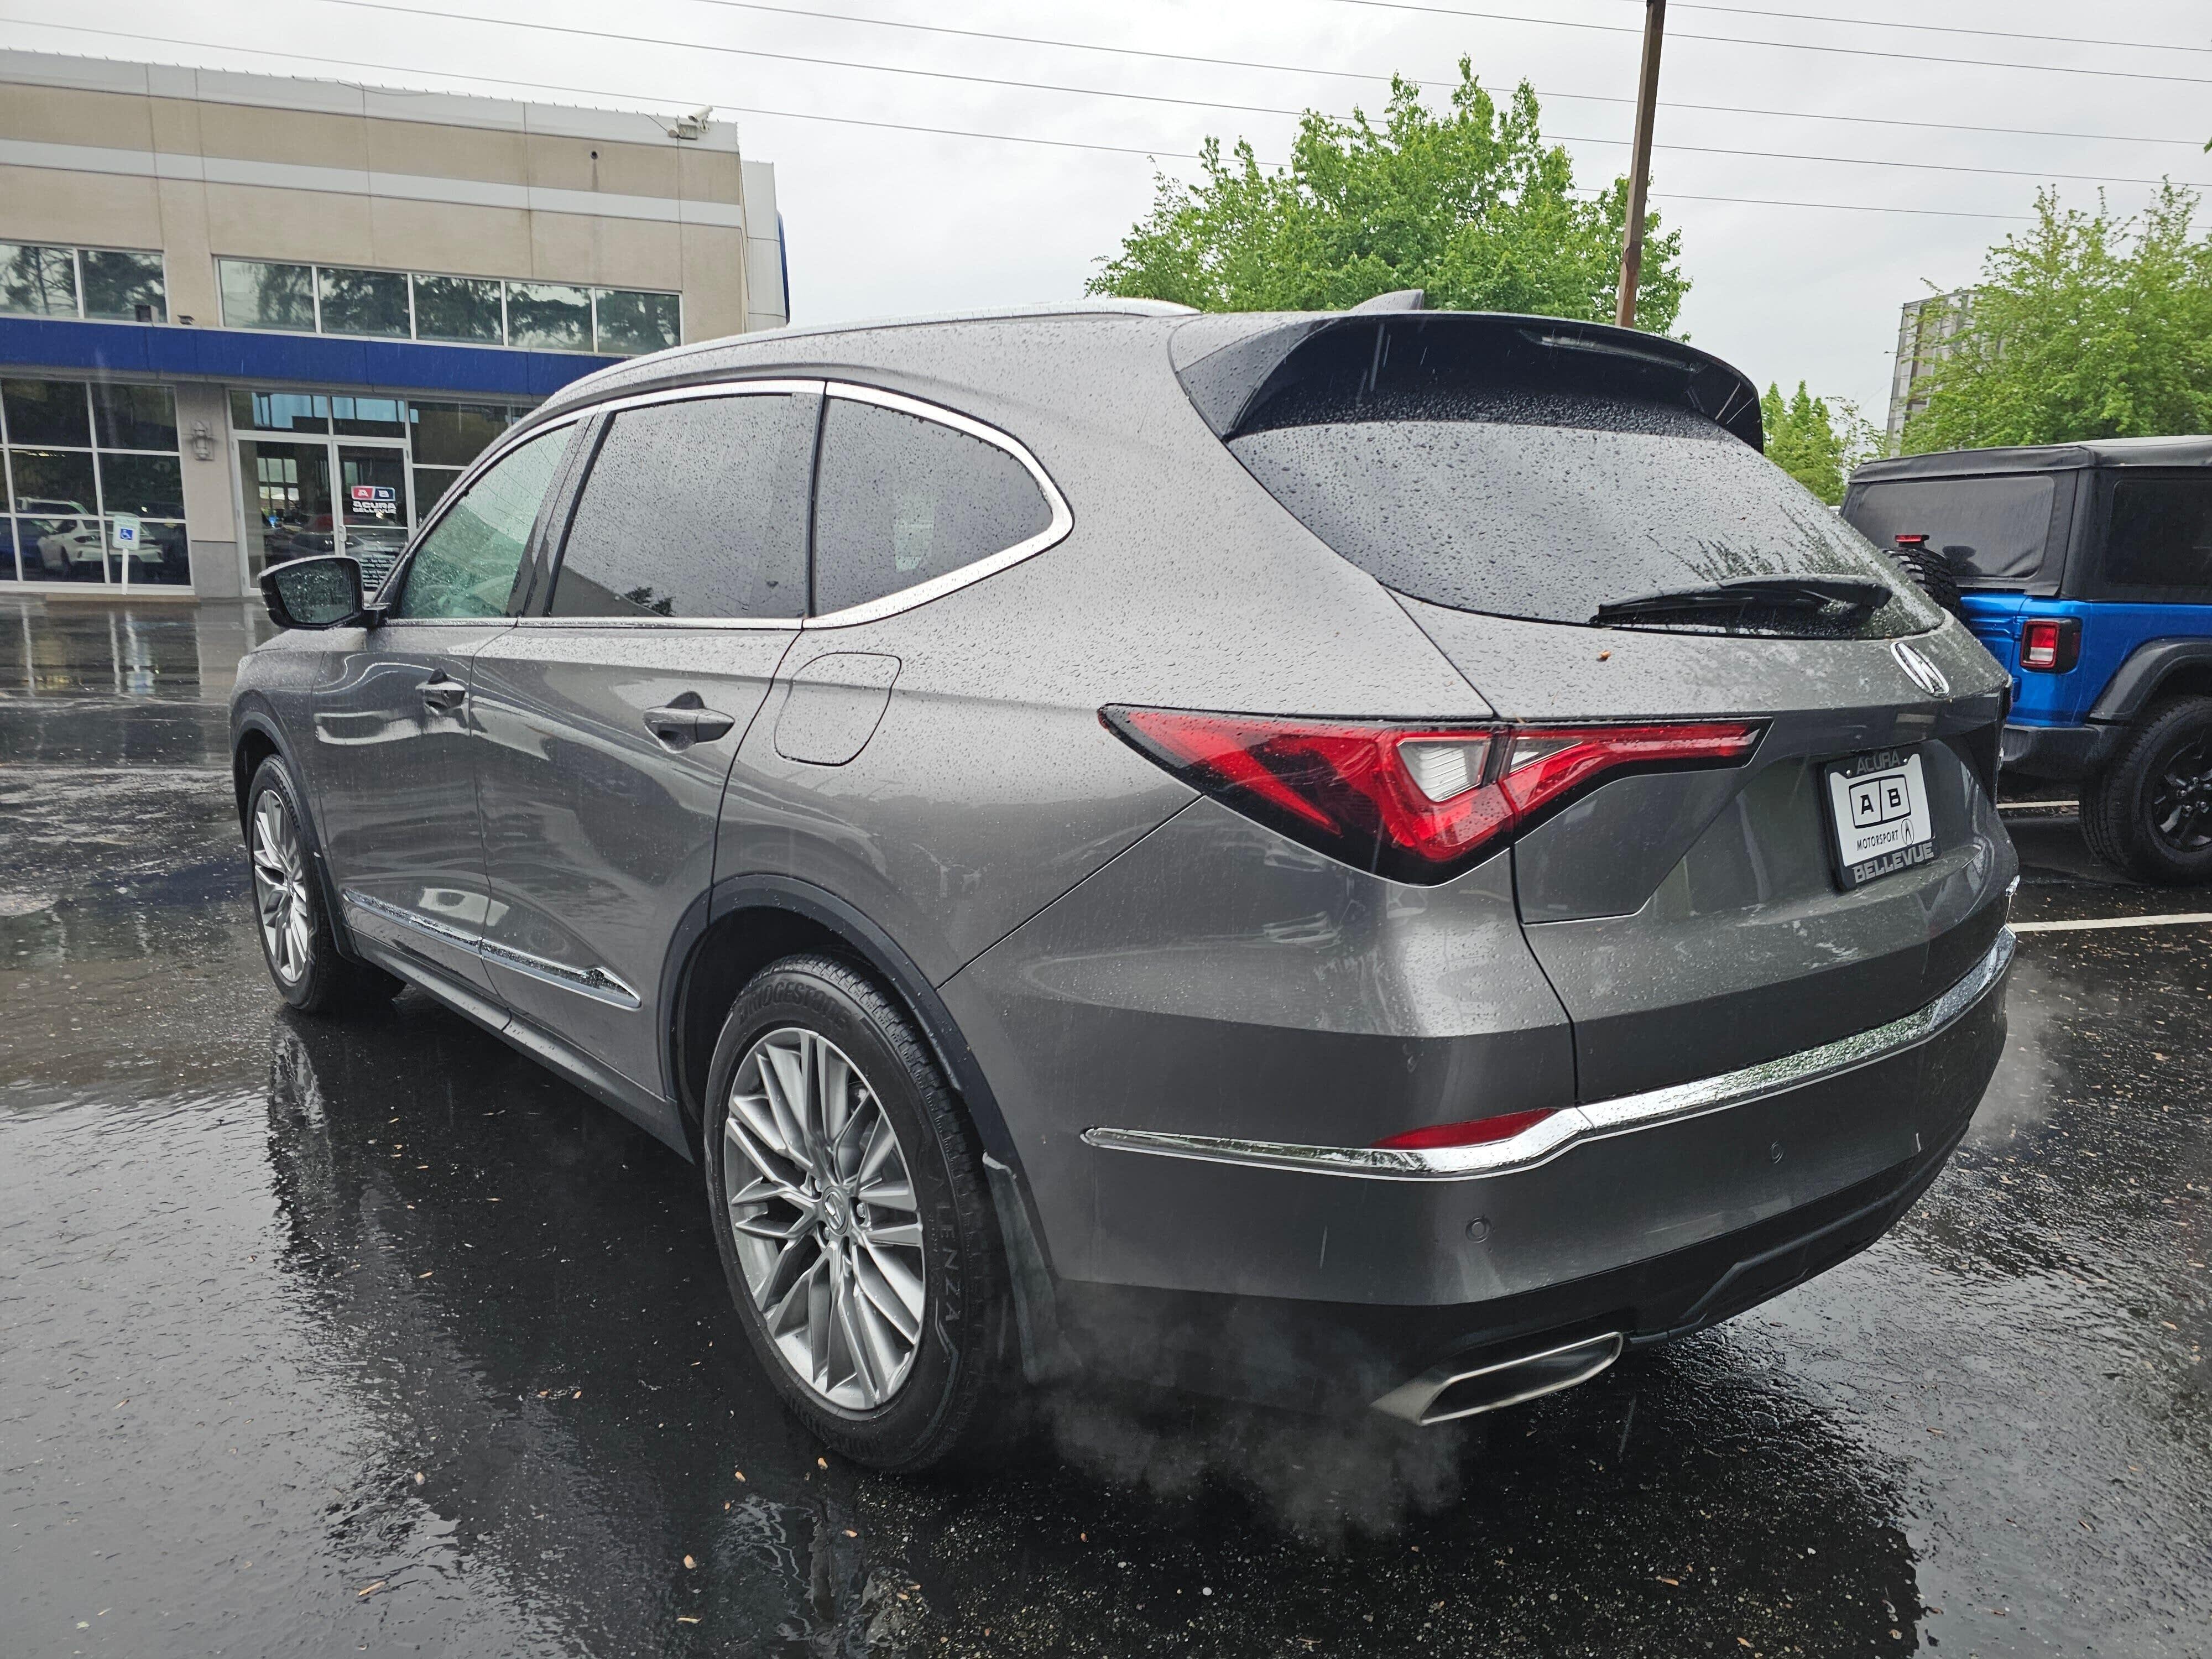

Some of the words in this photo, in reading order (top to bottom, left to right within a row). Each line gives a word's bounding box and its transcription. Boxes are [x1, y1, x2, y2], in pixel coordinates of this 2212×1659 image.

[353, 500, 397, 510] ACURA
[1856, 750, 1901, 774] ACURA
[1860, 794, 1874, 815] A
[1887, 788, 1902, 807] B
[1856, 830, 1898, 851] MOTORSPORT
[1852, 842, 1934, 884] BELLEVUE
